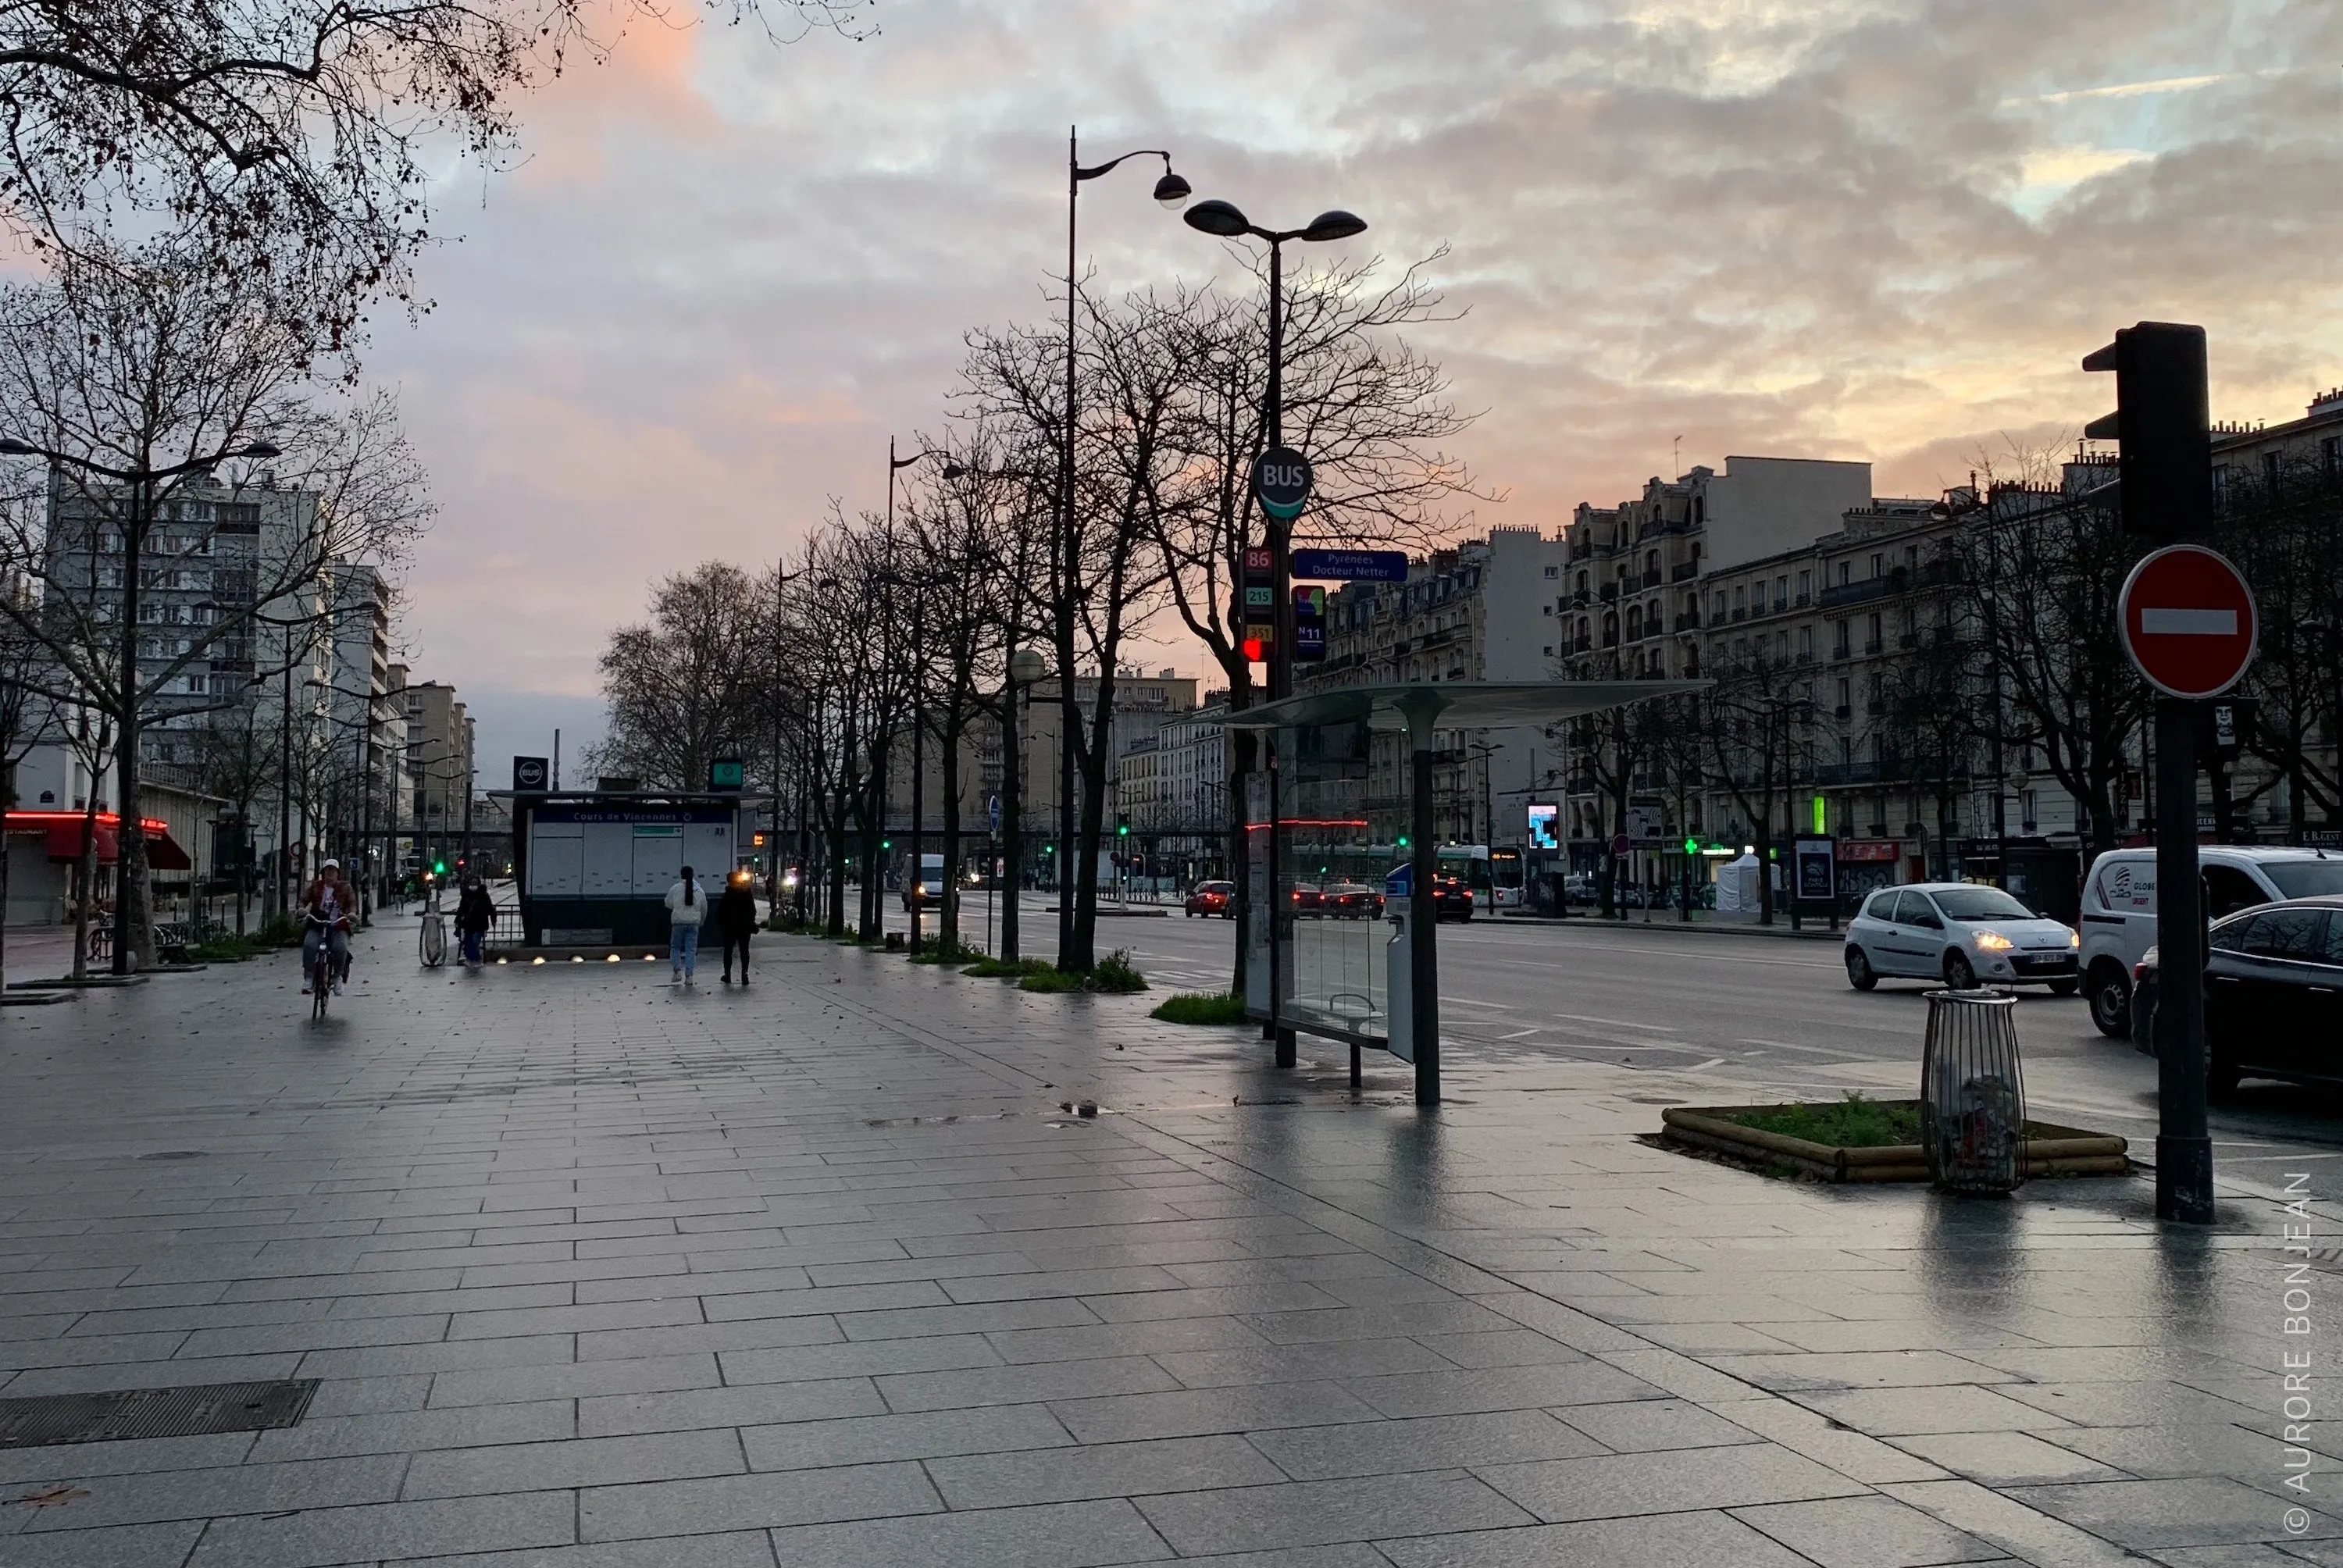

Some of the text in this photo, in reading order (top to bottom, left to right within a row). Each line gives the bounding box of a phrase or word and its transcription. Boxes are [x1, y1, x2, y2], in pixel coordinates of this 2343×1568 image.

[1263, 465, 1303, 486] BUS
[1250, 552, 1269, 567] 86
[1328, 553, 1373, 565] Pyrénées
[1313, 565, 1389, 576] Docteur Netter
[1250, 591, 1269, 601] 215
[522, 768, 540, 777] BUS
[2118, 770, 2127, 815] IZZA
[574, 812, 676, 821] Cours de Vincennes
[2134, 882, 2156, 890] GLOBE
